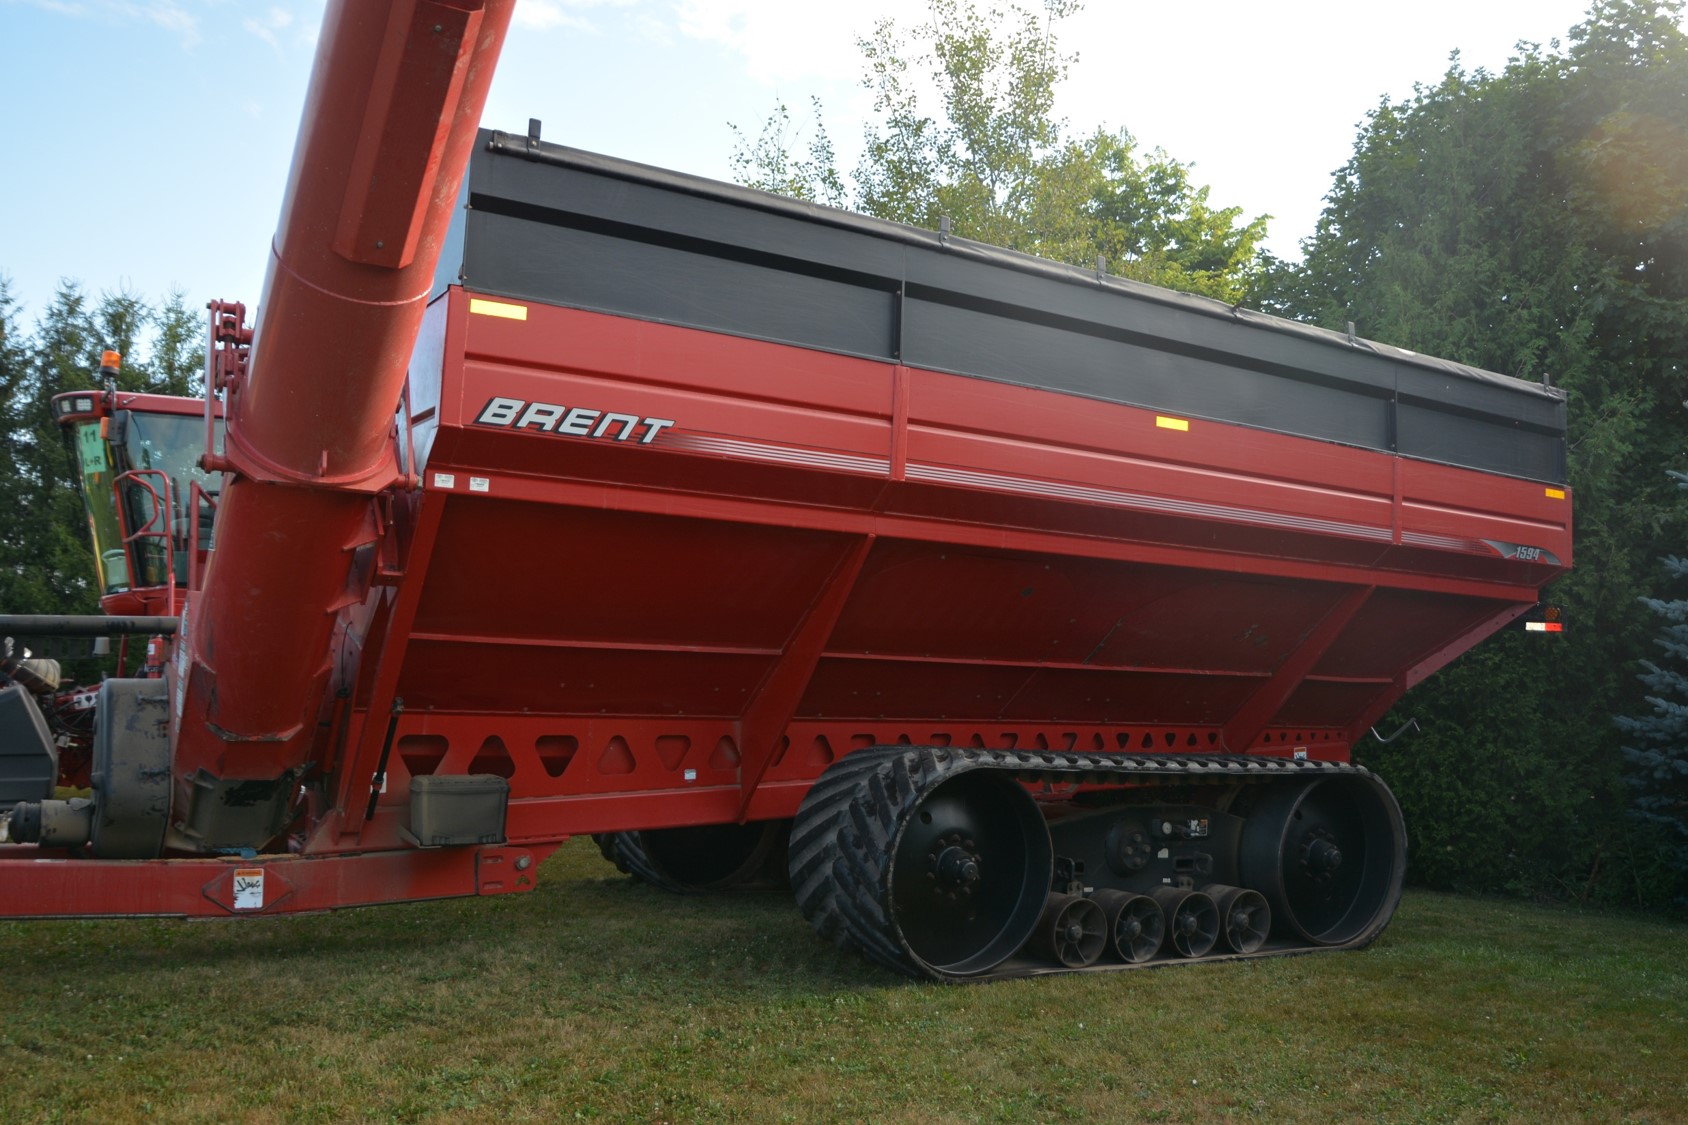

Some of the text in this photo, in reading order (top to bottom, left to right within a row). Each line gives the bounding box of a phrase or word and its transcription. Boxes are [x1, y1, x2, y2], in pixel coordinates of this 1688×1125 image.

[474, 397, 675, 444] BRENT
[83, 429, 97, 443] 11
[1516, 546, 1540, 560] 1594
